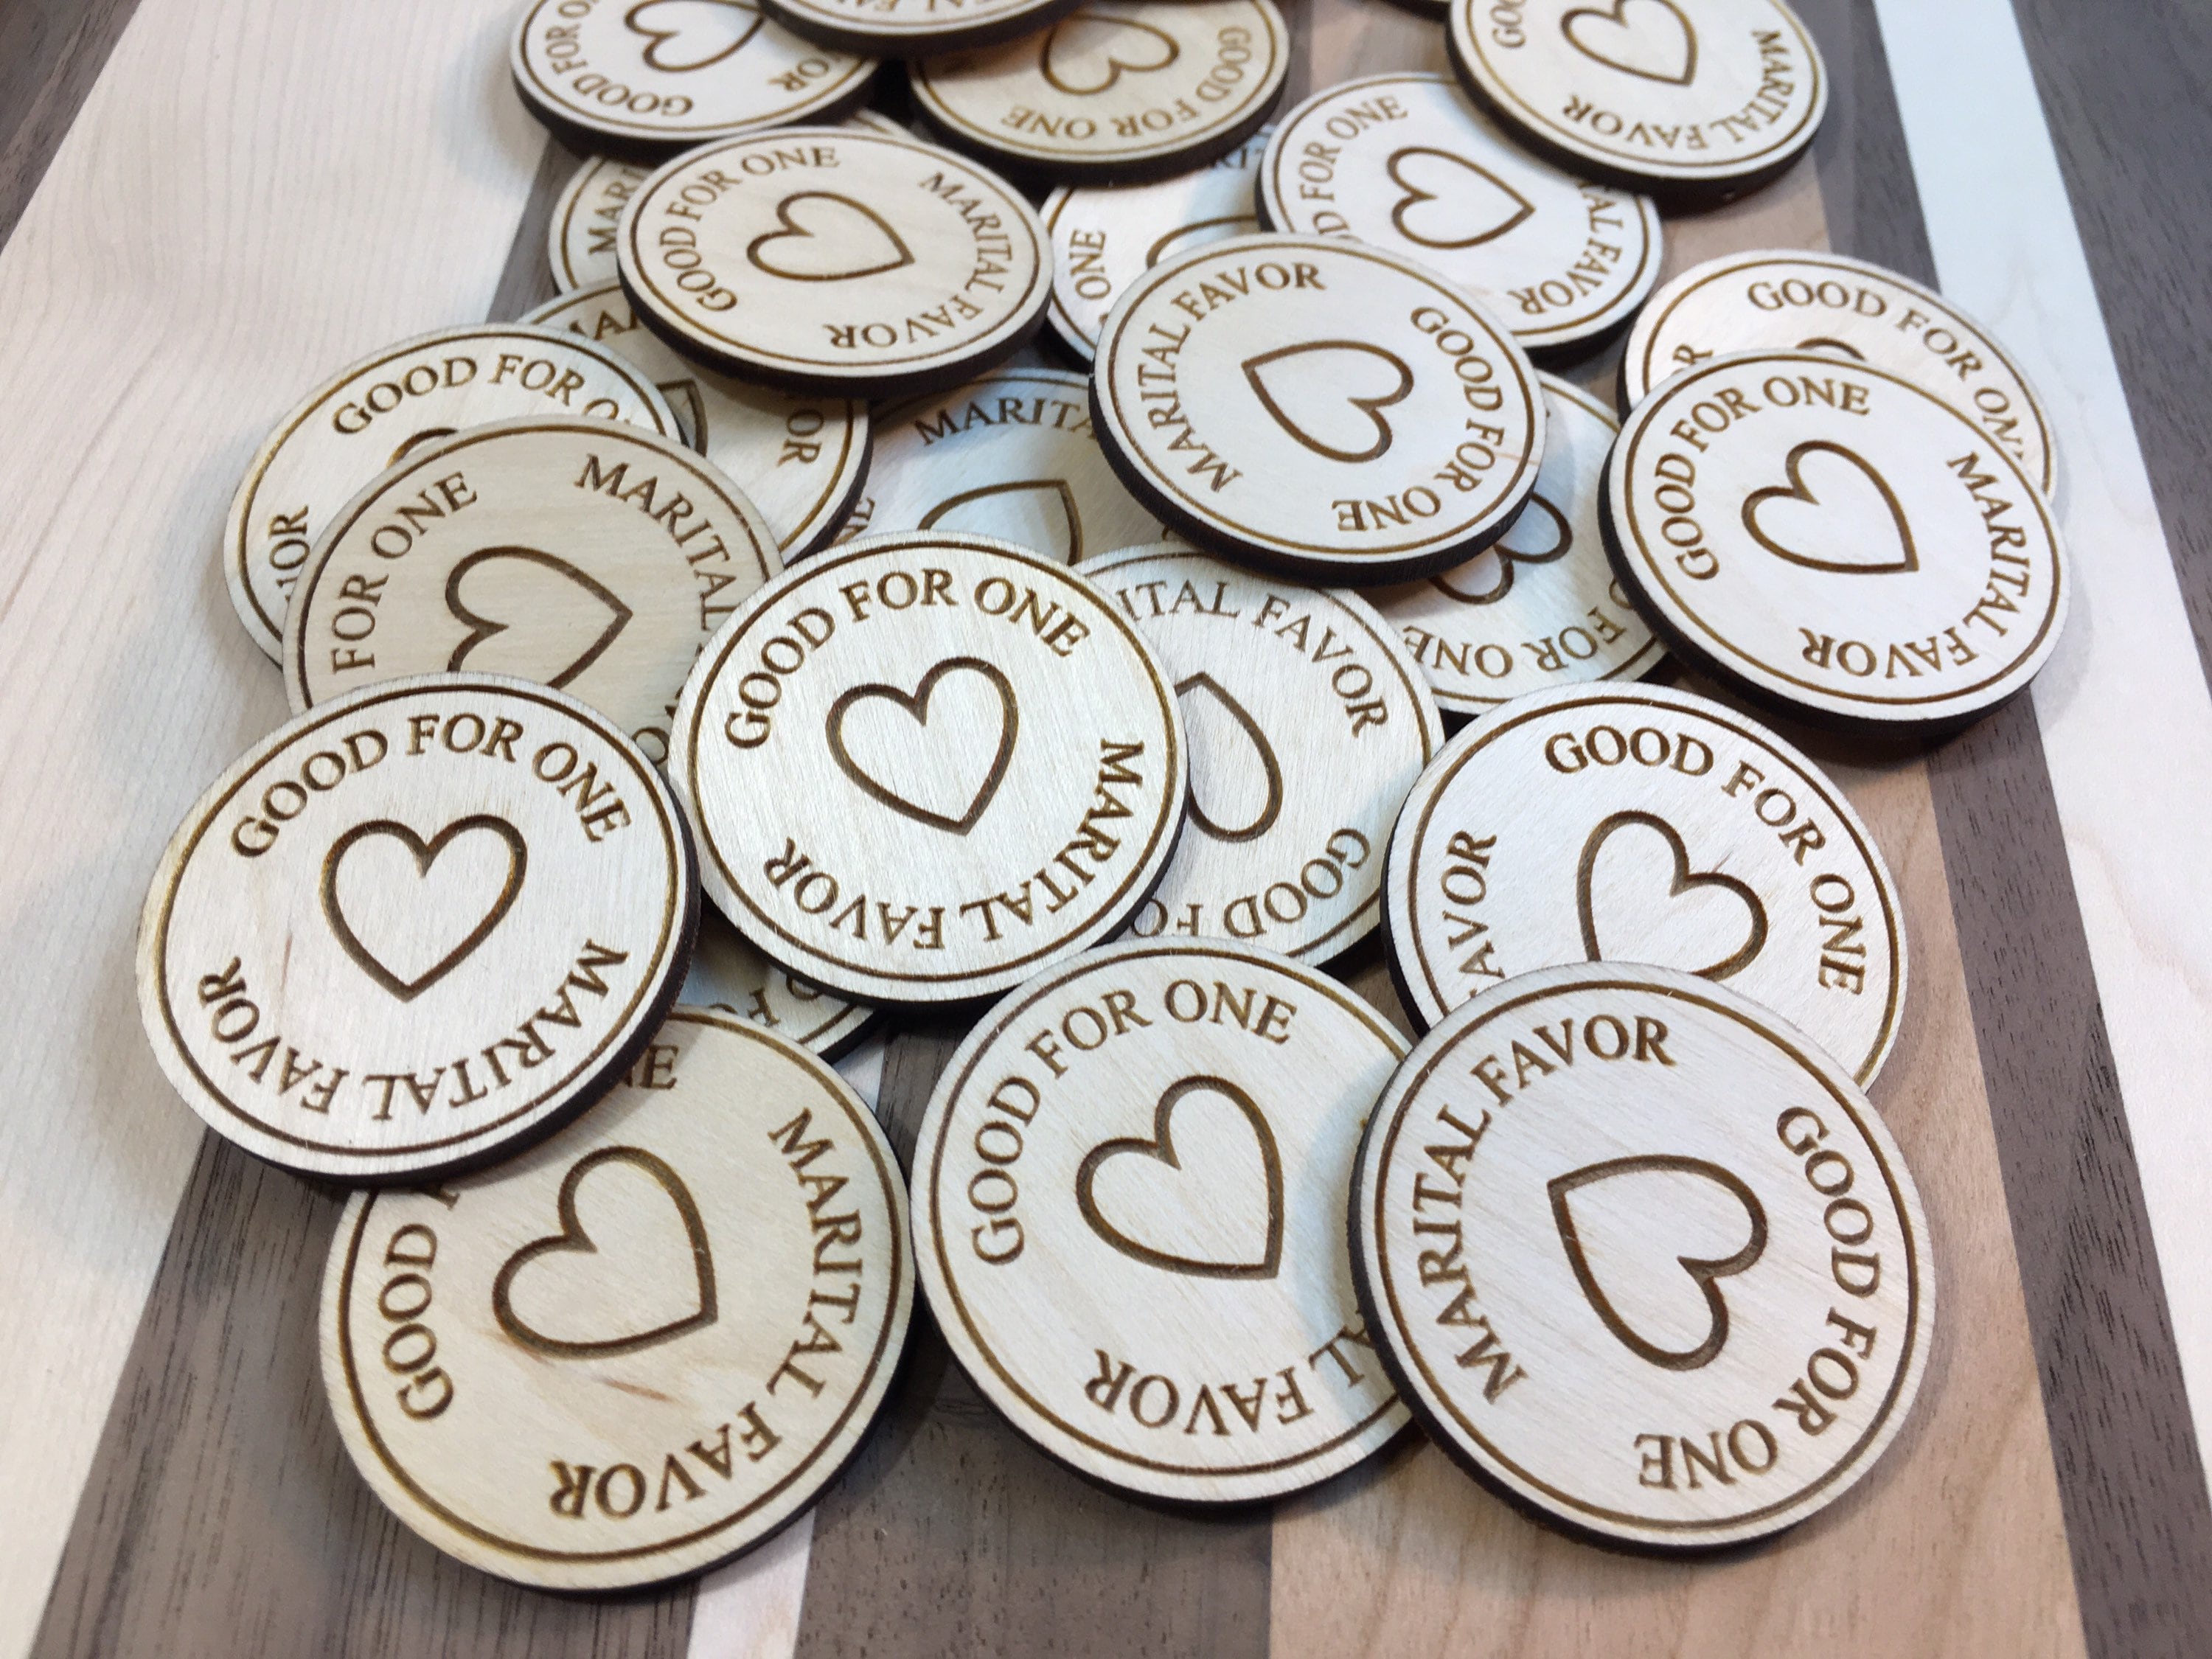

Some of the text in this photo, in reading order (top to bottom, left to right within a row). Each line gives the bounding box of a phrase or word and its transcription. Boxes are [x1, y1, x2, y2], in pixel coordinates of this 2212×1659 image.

[741, 147, 840, 175] ONE
[1001, 27, 1251, 139] GOOD FOR ONE
[1299, 142, 1341, 201] FOR
[1327, 95, 1410, 141] ONE
[1562, 29, 1796, 149] MARITAL FAVOR
[588, 166, 649, 255] MARI
[660, 227, 737, 311] GOOD
[667, 170, 742, 221] FOR
[822, 171, 1012, 348] MARITAL FAVOR
[1069, 228, 1111, 300] ONE
[1507, 237, 1623, 314] FAVOR
[333, 354, 585, 434] GOOD FOR
[914, 397, 1097, 446] MARITA
[1138, 262, 1326, 493] MARITAL FAVOR
[1331, 307, 1505, 531] GOOD FOR ONE
[1747, 279, 2025, 459] GOOD FOR ON
[574, 453, 738, 631] MARITAL
[1655, 377, 1871, 580] GOOD FOR ONE
[1798, 451, 2031, 679] MARITAL FAVOR
[330, 471, 478, 675] FOR ONE
[725, 607, 835, 748] GOOD
[838, 568, 958, 624] FOR
[973, 577, 1090, 657] ONE
[1116, 579, 1388, 739] ITAL FAVOR
[1402, 606, 1627, 678] FOR ONE
[231, 713, 631, 858] GOOD FOR ONE
[763, 738, 1145, 950] MARITAL FAVOR
[1545, 725, 1866, 996] GOOD FOR ONE
[1131, 827, 1371, 939] GOOD FO
[1441, 829, 1504, 998] AVOR
[198, 939, 628, 1121] MARITAL FAVOR
[967, 978, 1297, 1265] GOOD FOR ONE
[1413, 1014, 1677, 1403] MARITAL FAVOR
[378, 1223, 454, 1422] GOOD
[549, 1107, 862, 1518] MARITAL FAVOR
[1634, 1106, 1880, 1489] GOOD FOR ONE
[1084, 1349, 1315, 1436] FAVOR
